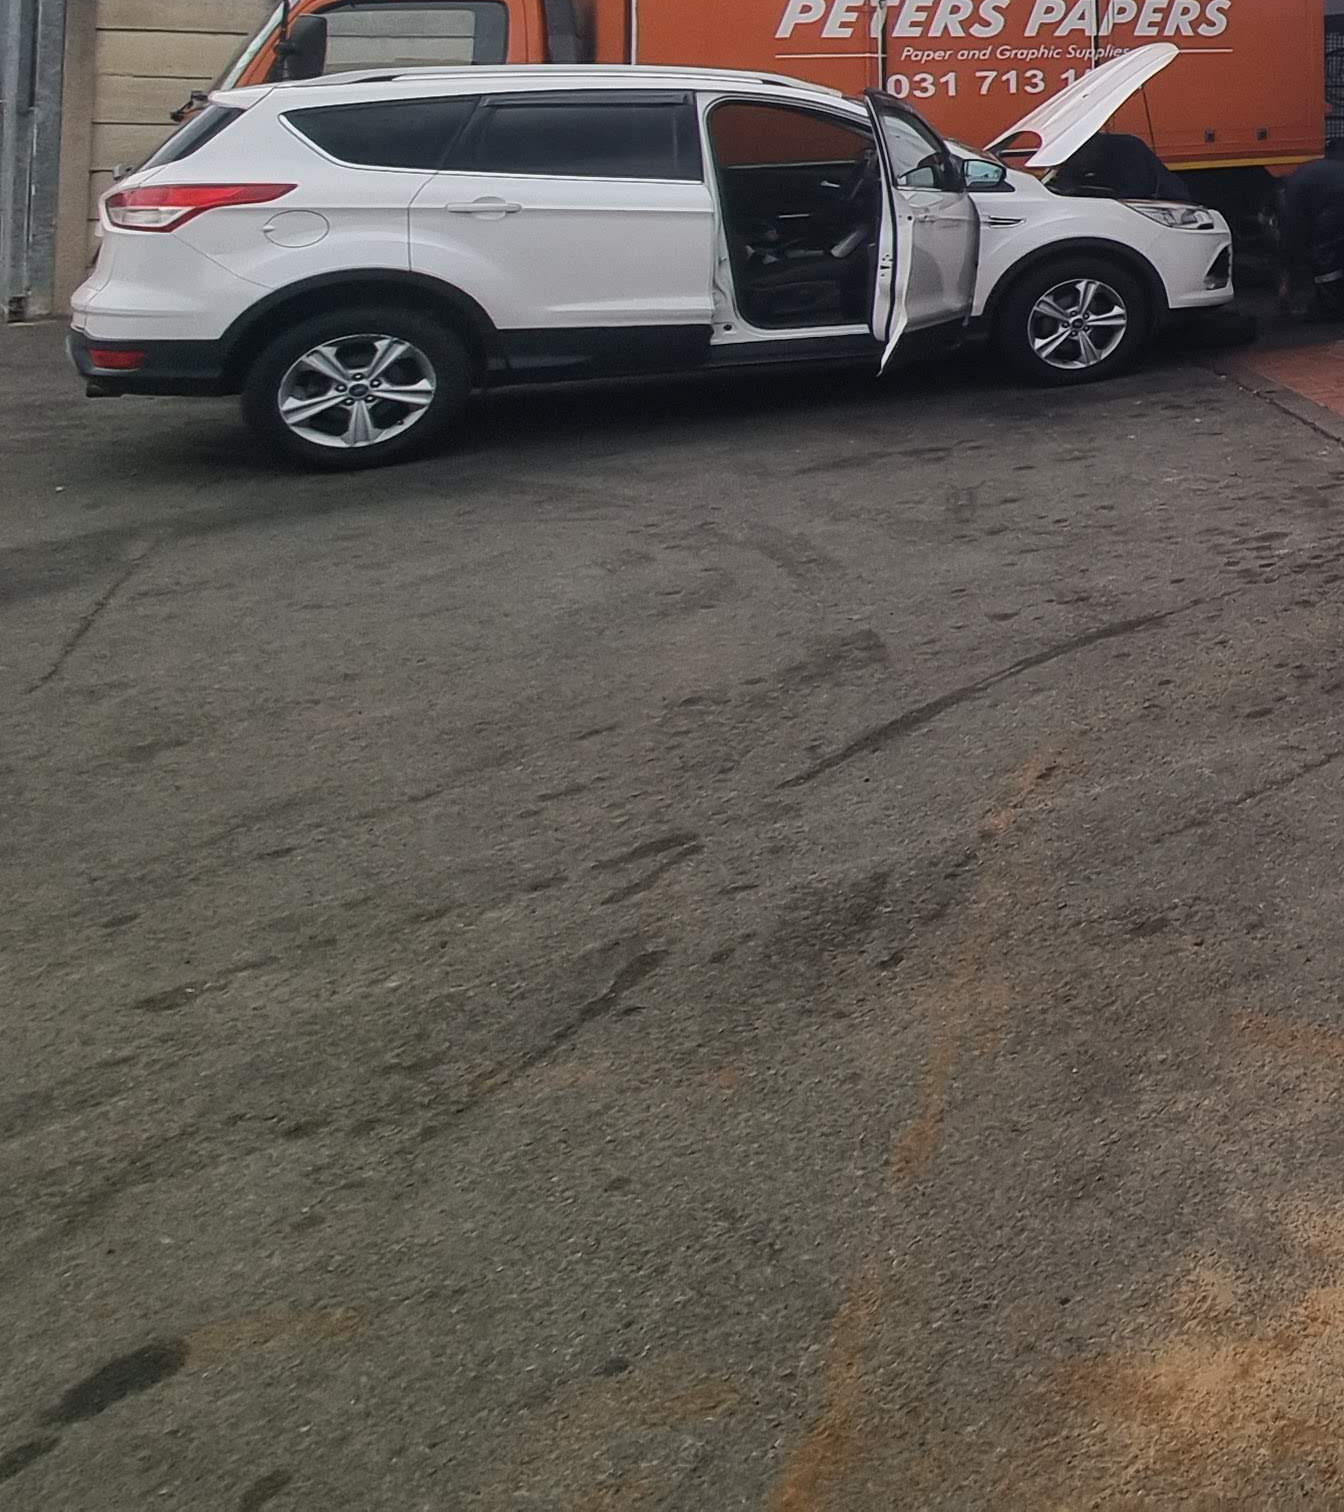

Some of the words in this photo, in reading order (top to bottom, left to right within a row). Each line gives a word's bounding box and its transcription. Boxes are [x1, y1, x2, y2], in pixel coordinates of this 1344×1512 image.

[900, 46, 954, 64] Paper
[956, 44, 993, 61] and
[996, 44, 1063, 63] Graphic
[886, 71, 957, 100] 031
[975, 68, 1046, 95] 713
